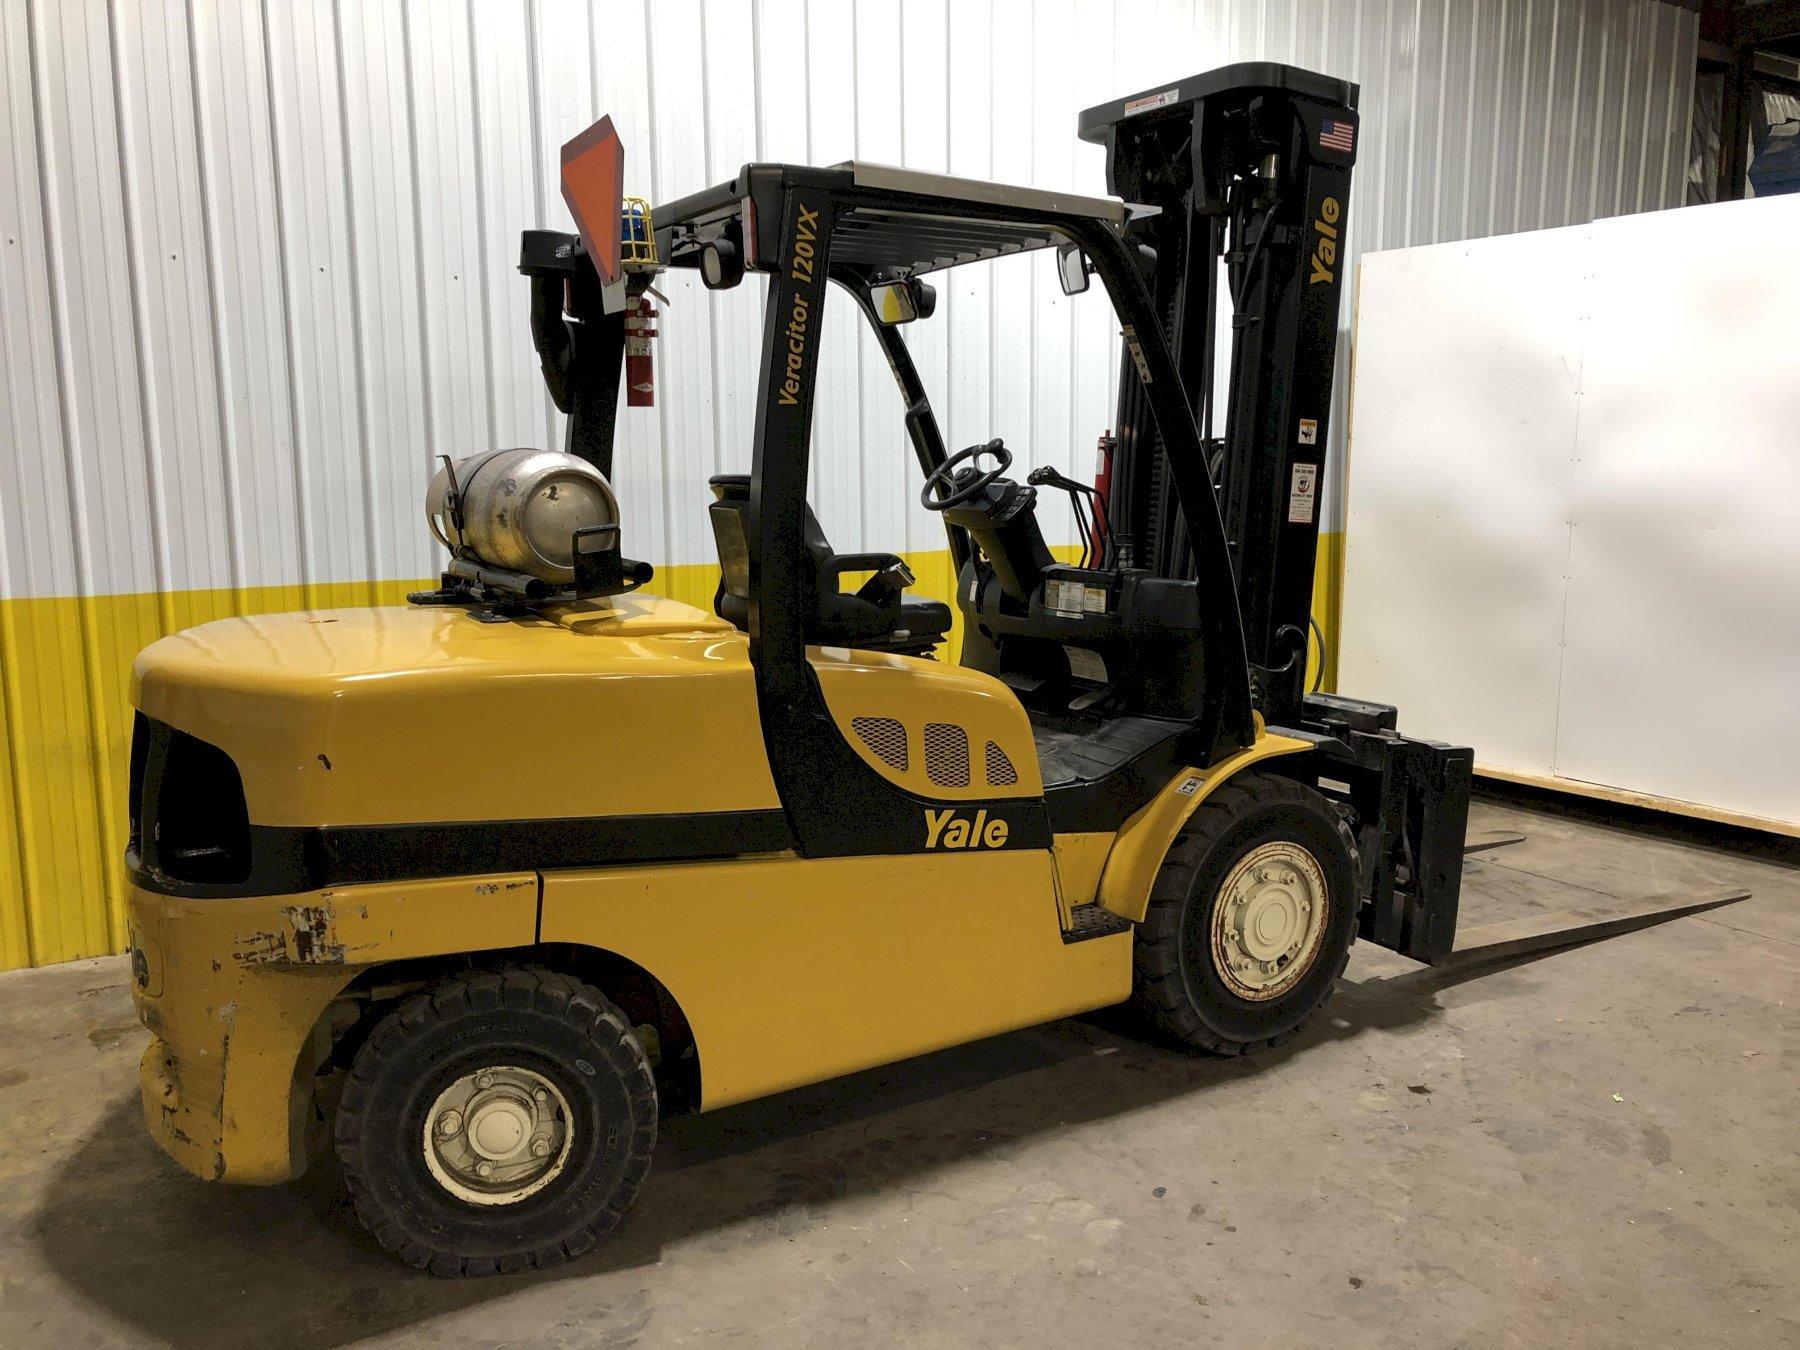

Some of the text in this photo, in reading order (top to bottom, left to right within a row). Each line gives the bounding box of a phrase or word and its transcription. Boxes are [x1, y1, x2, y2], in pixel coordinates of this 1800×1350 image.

[1309, 196, 1340, 285] Yale
[778, 202, 819, 406] Veracitor 120VX
[924, 809, 1009, 848] Yale
